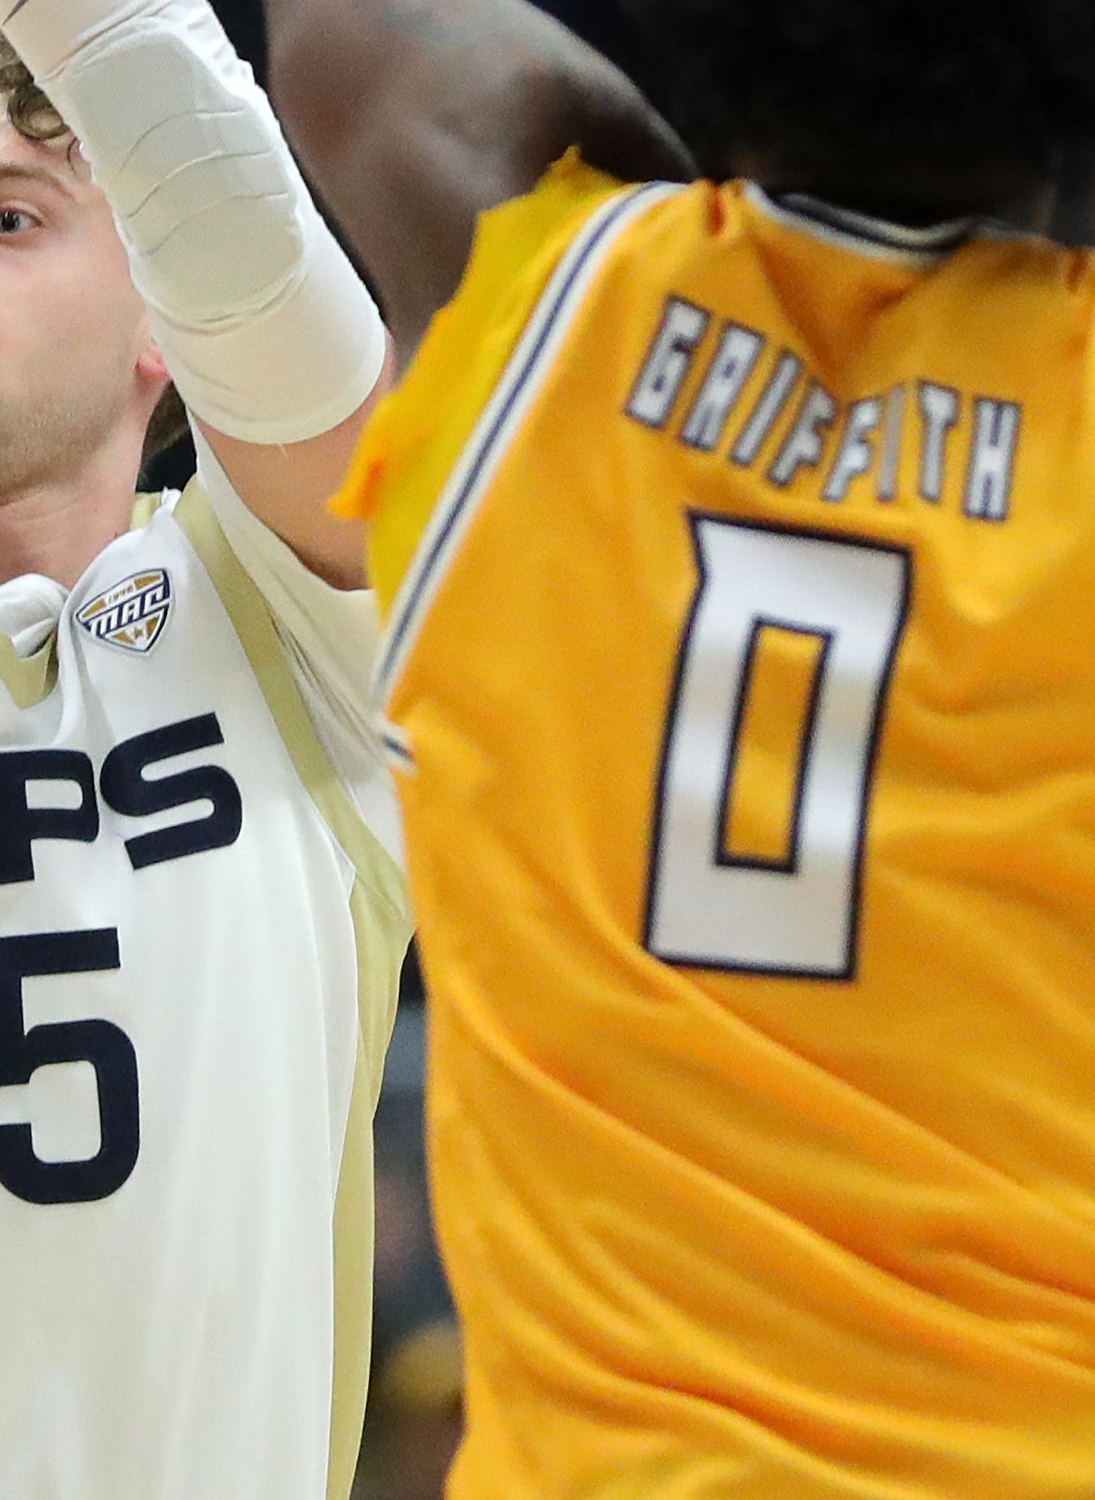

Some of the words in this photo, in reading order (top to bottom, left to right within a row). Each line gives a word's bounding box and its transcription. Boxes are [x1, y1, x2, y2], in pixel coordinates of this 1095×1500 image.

[625, 293, 1021, 522] GRIFFITH
[88, 585, 165, 636] MAC
[642, 506, 913, 983] 0
